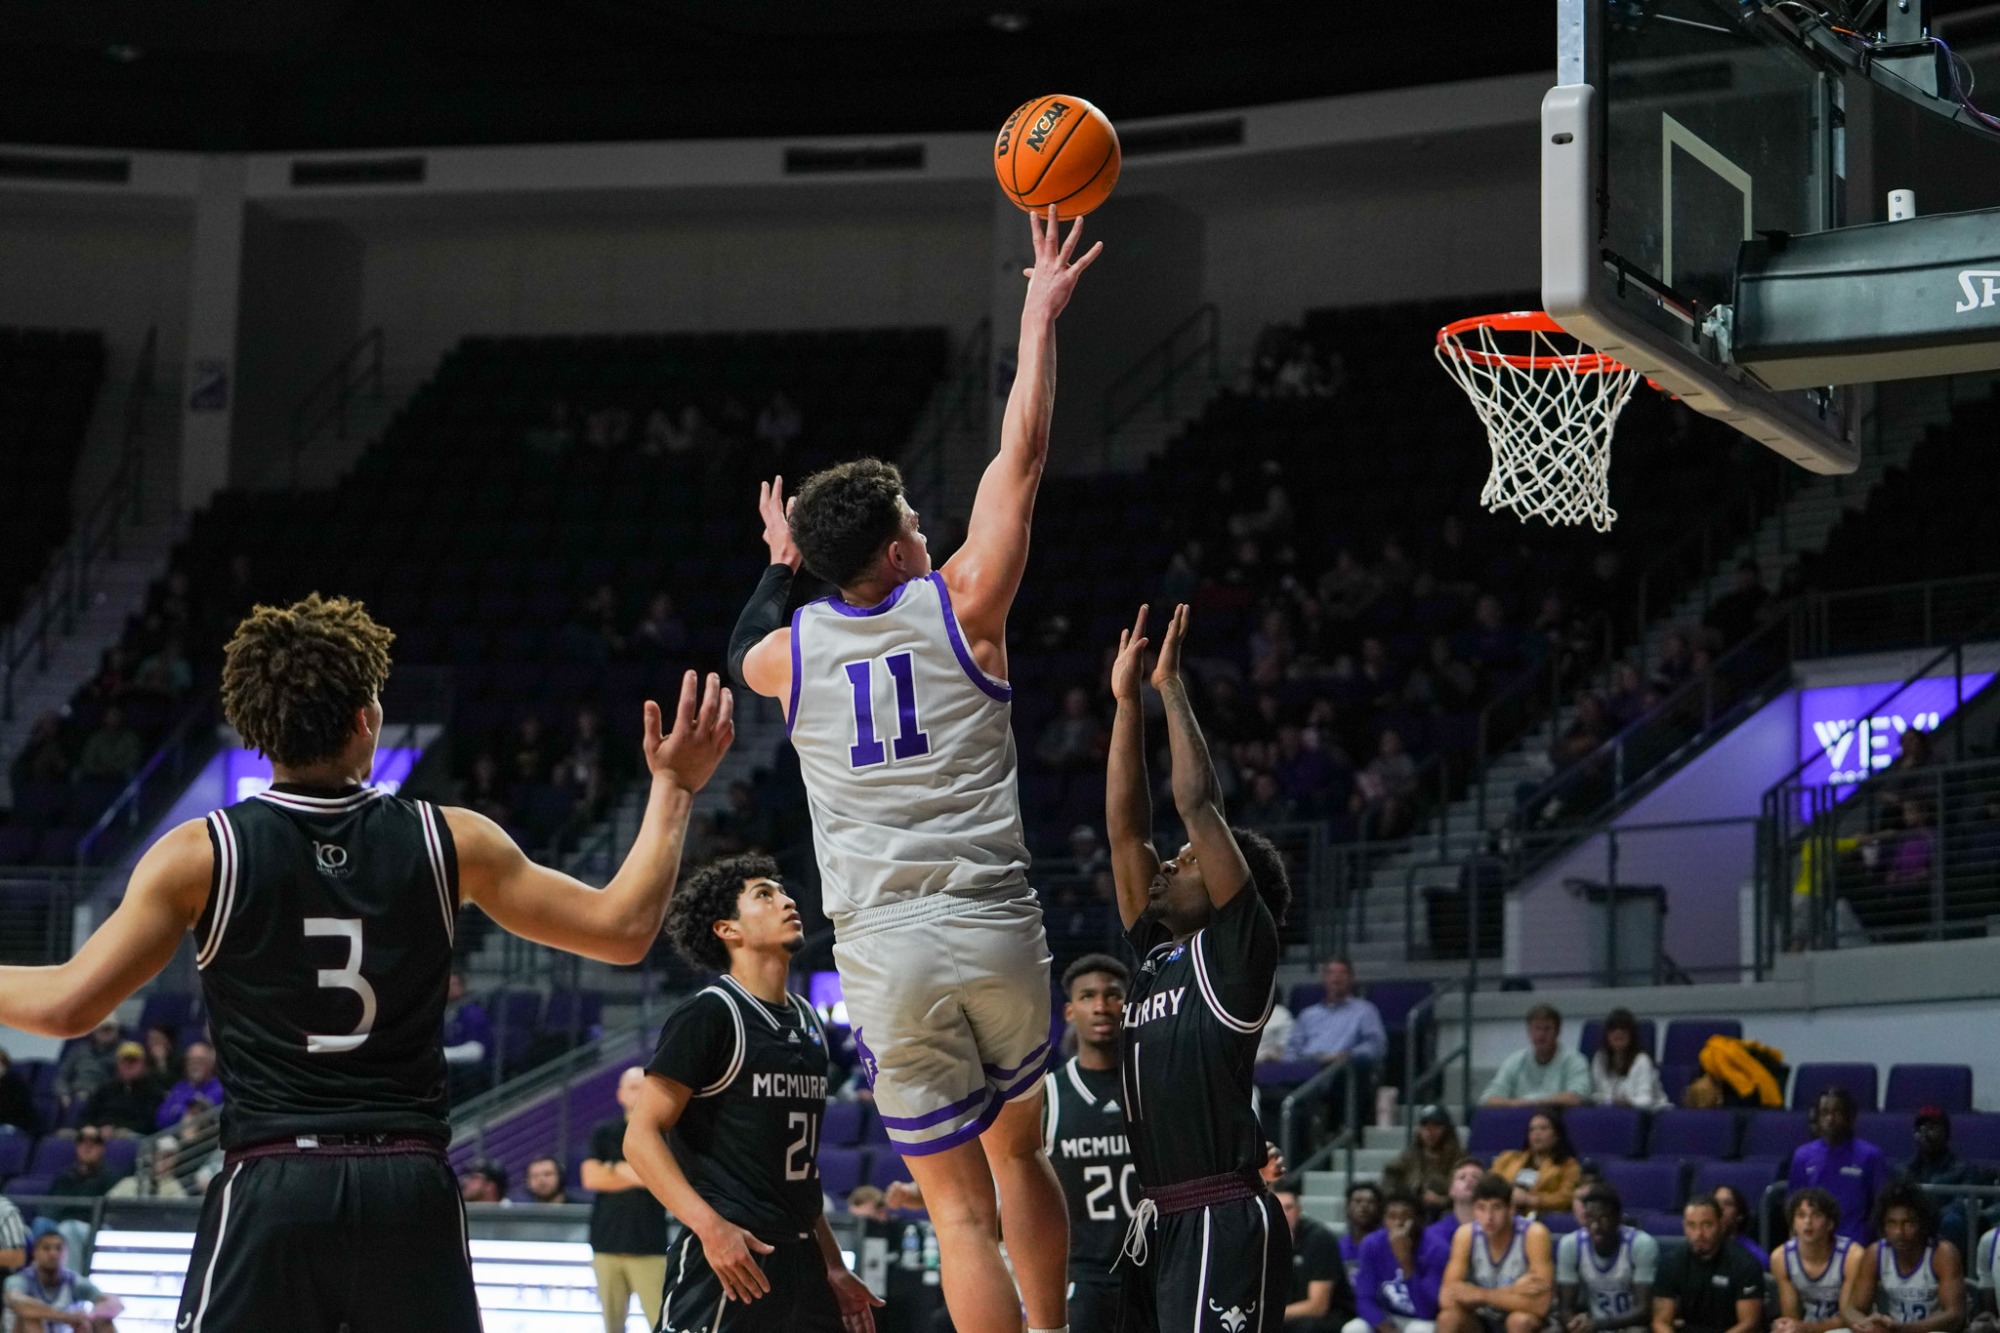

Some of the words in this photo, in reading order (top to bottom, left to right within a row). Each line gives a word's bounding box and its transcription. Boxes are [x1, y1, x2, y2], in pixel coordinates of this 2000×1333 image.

[1026, 101, 1071, 153] NCAA
[841, 649, 932, 770] 11
[303, 917, 377, 1053] 3
[752, 1072, 829, 1100] MCMURR
